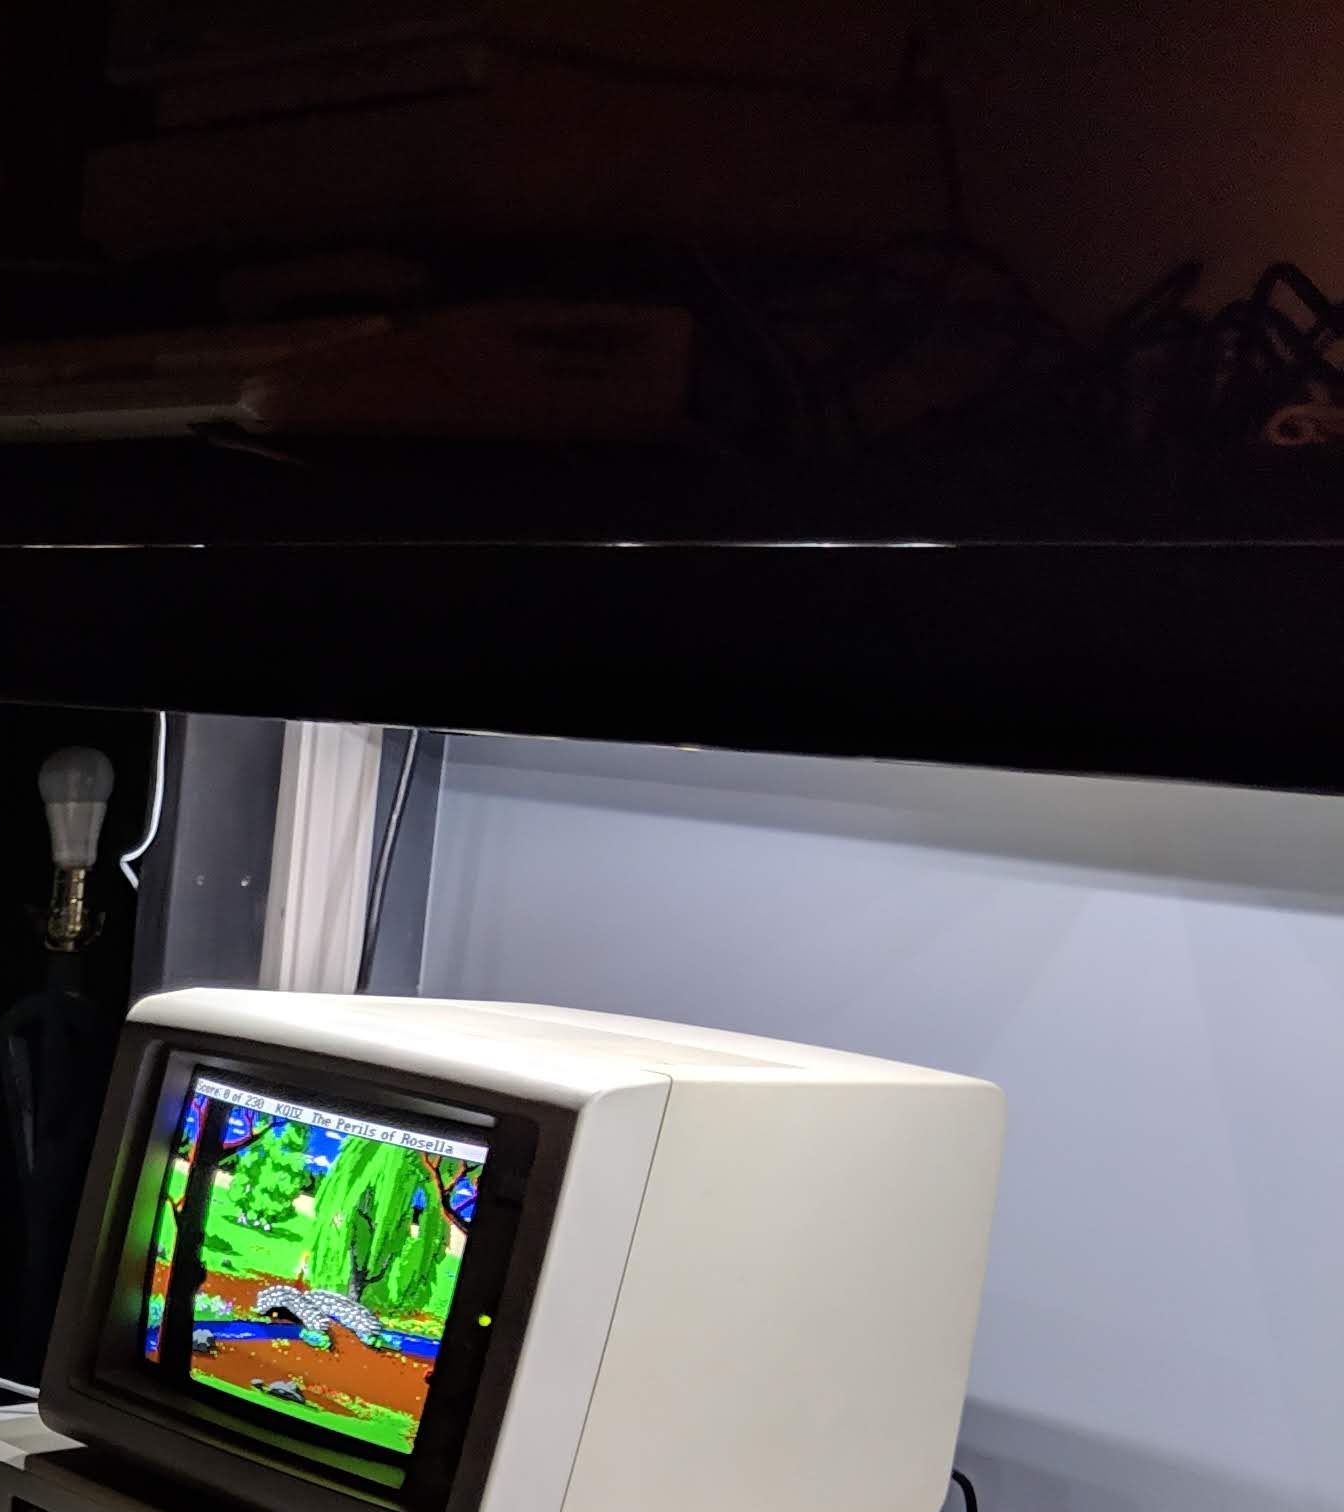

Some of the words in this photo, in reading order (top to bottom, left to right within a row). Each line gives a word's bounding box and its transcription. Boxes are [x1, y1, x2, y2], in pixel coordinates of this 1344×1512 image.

[232, 1091, 243, 1103] of
[312, 1112, 332, 1127] The
[335, 1117, 377, 1138] Perils
[380, 1130, 397, 1142] of
[400, 1132, 455, 1155] Rosella
